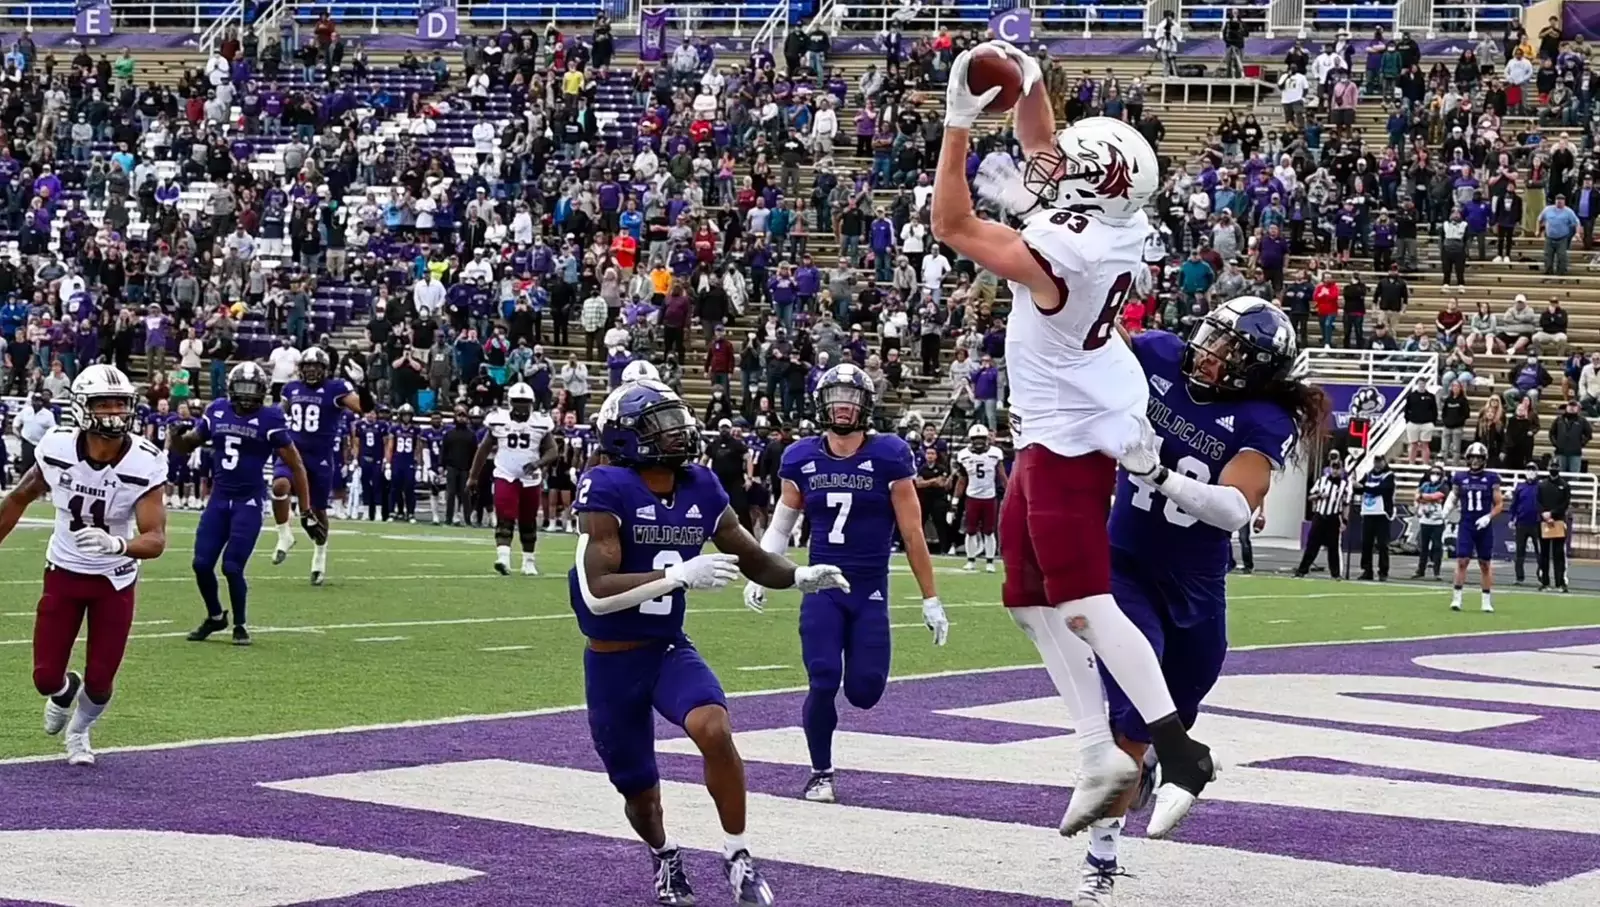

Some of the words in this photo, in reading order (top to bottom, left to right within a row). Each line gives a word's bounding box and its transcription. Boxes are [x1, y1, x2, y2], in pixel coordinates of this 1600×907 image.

[87, 9, 101, 34] E
[428, 12, 448, 38] D
[999, 14, 1020, 41] C
[1049, 211, 1089, 234] 83
[291, 403, 320, 432] 98
[1147, 396, 1226, 461] WILDCATS
[1350, 419, 1369, 448] 4
[221, 435, 242, 471] 5
[808, 473, 874, 491] WILDCATS
[976, 464, 987, 479] 5
[578, 479, 593, 504] 2
[1466, 490, 1484, 511] 11
[68, 494, 110, 535] 11
[827, 492, 853, 545] 7
[633, 524, 705, 547] WILDCATS
[638, 550, 684, 616] 2
